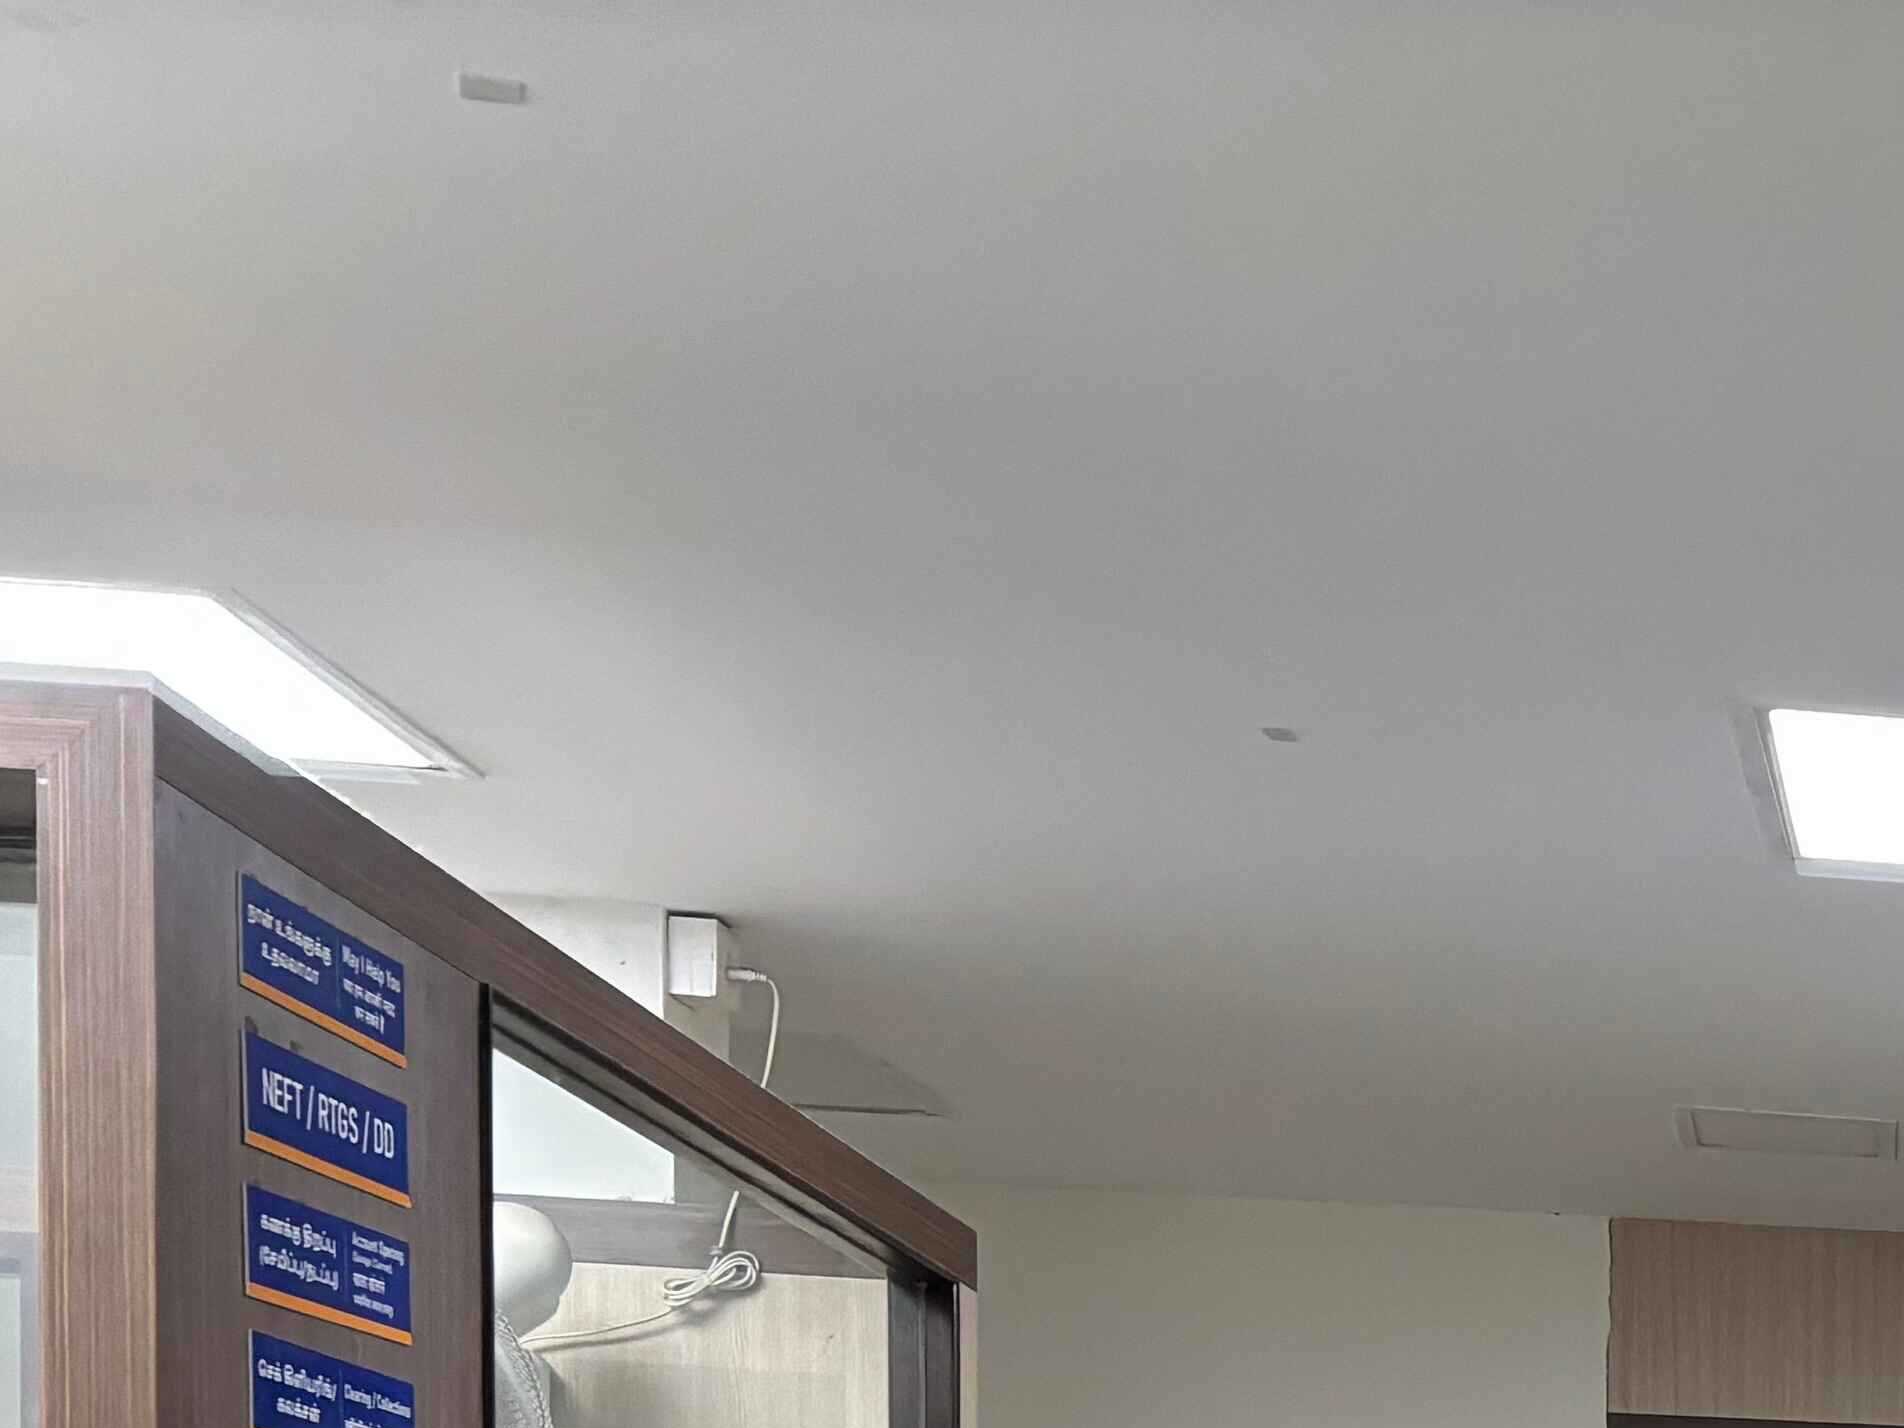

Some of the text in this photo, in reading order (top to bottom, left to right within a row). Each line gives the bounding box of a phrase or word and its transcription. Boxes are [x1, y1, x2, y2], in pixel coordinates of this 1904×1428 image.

[262, 1068, 304, 1121] NEFT
[318, 1093, 359, 1145] RTGS
[374, 1117, 395, 1160] DD
